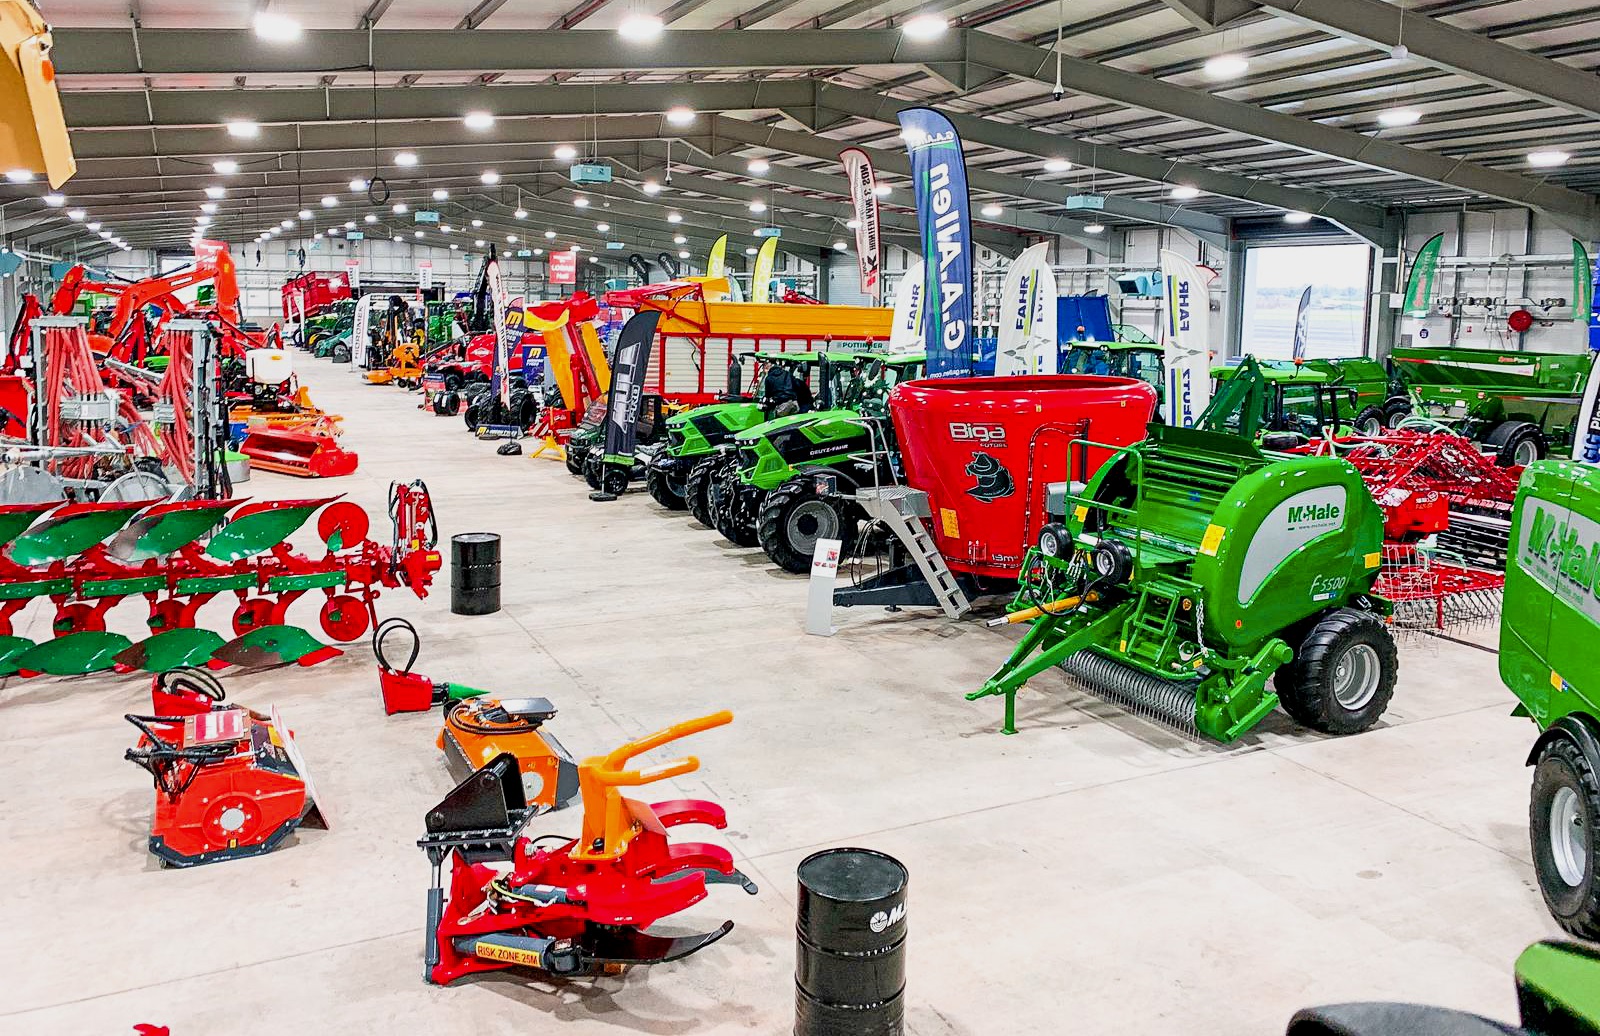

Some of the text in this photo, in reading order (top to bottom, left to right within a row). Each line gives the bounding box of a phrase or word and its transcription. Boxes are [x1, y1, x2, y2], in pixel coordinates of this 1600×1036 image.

[907, 284, 921, 330] FAHR
[1016, 275, 1030, 330] FAHR
[949, 422, 1006, 442] Biga
[809, 444, 849, 456] DEUTZ-FAHR
[1287, 503, 1340, 523] McHale
[1309, 574, 1346, 596] F5500
[477, 945, 538, 965] RISK ZONE 25M
